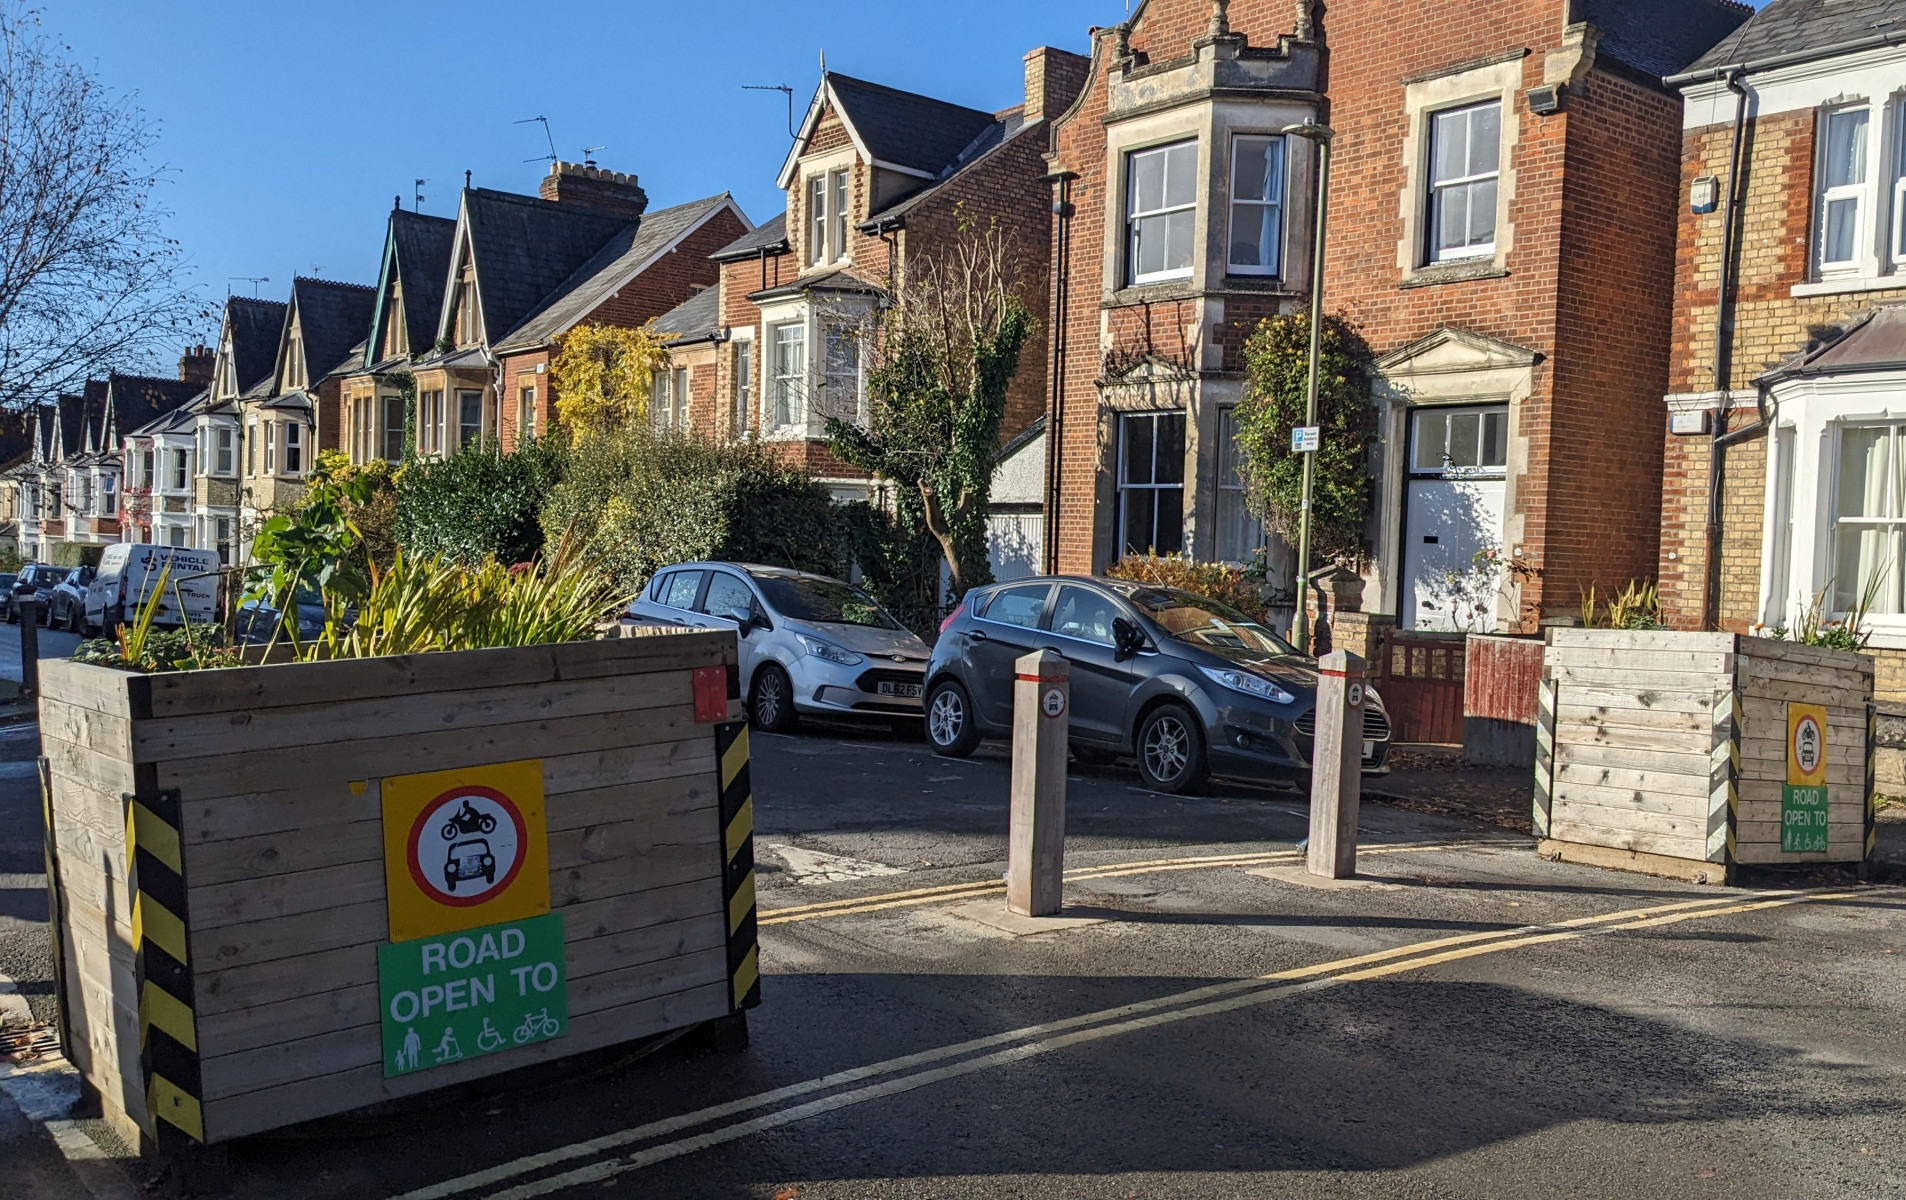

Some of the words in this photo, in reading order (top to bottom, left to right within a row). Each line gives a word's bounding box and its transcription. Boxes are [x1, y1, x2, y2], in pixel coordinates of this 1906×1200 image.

[160, 554, 209, 565] VEHICLE
[882, 683, 905, 695] DL62
[1792, 789, 1819, 805] ROAD
[1784, 810, 1811, 826] OPEN
[1814, 811, 1826, 827] TO
[421, 928, 525, 975] ROAD
[390, 973, 495, 1023] OPEN
[510, 962, 558, 996] TO
